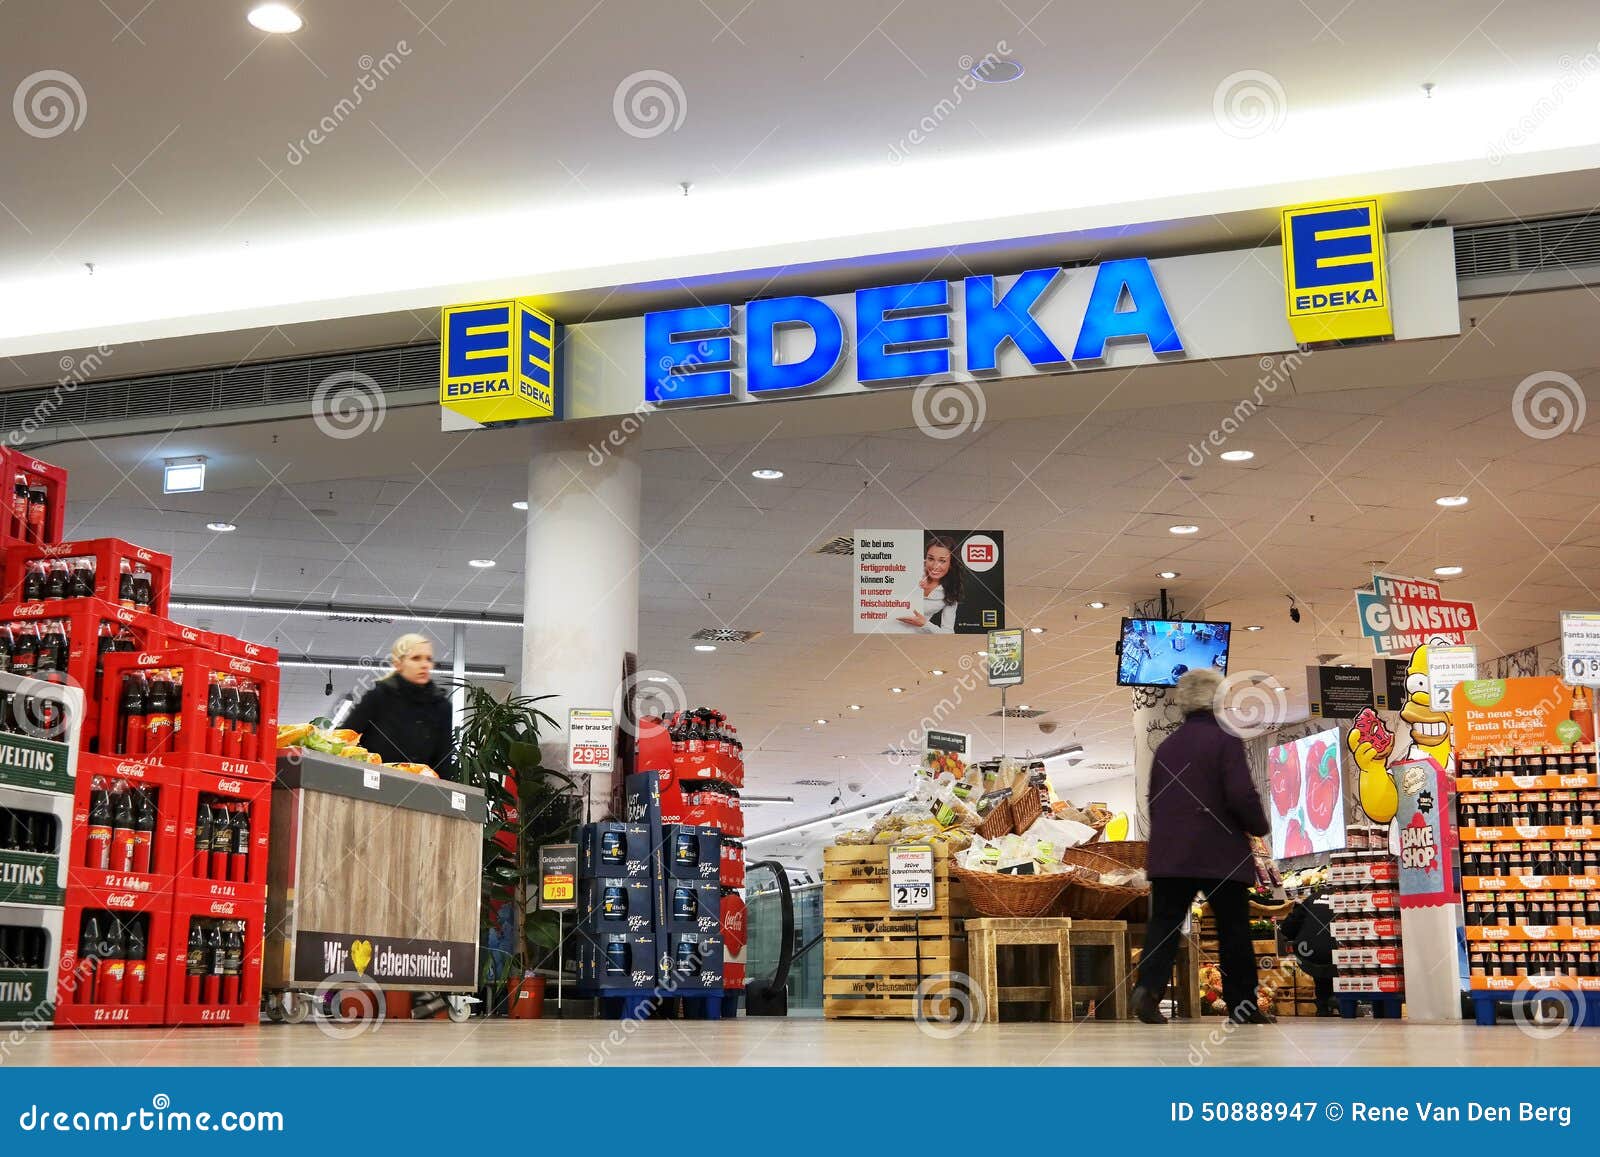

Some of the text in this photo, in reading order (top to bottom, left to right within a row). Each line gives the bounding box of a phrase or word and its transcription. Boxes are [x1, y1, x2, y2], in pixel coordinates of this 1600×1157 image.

[1291, 207, 1374, 289] E
[1296, 288, 1378, 310] EDEKA
[644, 257, 1185, 403] EDEKA
[448, 307, 509, 378] E
[447, 379, 510, 397] EDEKA
[520, 381, 551, 406] EDEKA
[872, 539, 881, 547] bei
[861, 552, 892, 561] gekauften
[861, 563, 907, 573] Fertigprodukte
[861, 575, 895, 584] können Sie
[868, 588, 893, 596] unserer
[1378, 579, 1438, 600] HYPER
[861, 600, 911, 609] Fleischabteilung
[1365, 598, 1471, 632] GÜNSTIG
[137, 653, 162, 665] Coke
[1467, 708, 1544, 719] Die neue Sorte
[1467, 721, 1499, 731] Fanta
[1401, 825, 1434, 848] BAKE
[1401, 846, 1436, 869] SHOP
[324, 941, 453, 978] Wir Lebensmittel.
[852, 983, 864, 991] Wir
